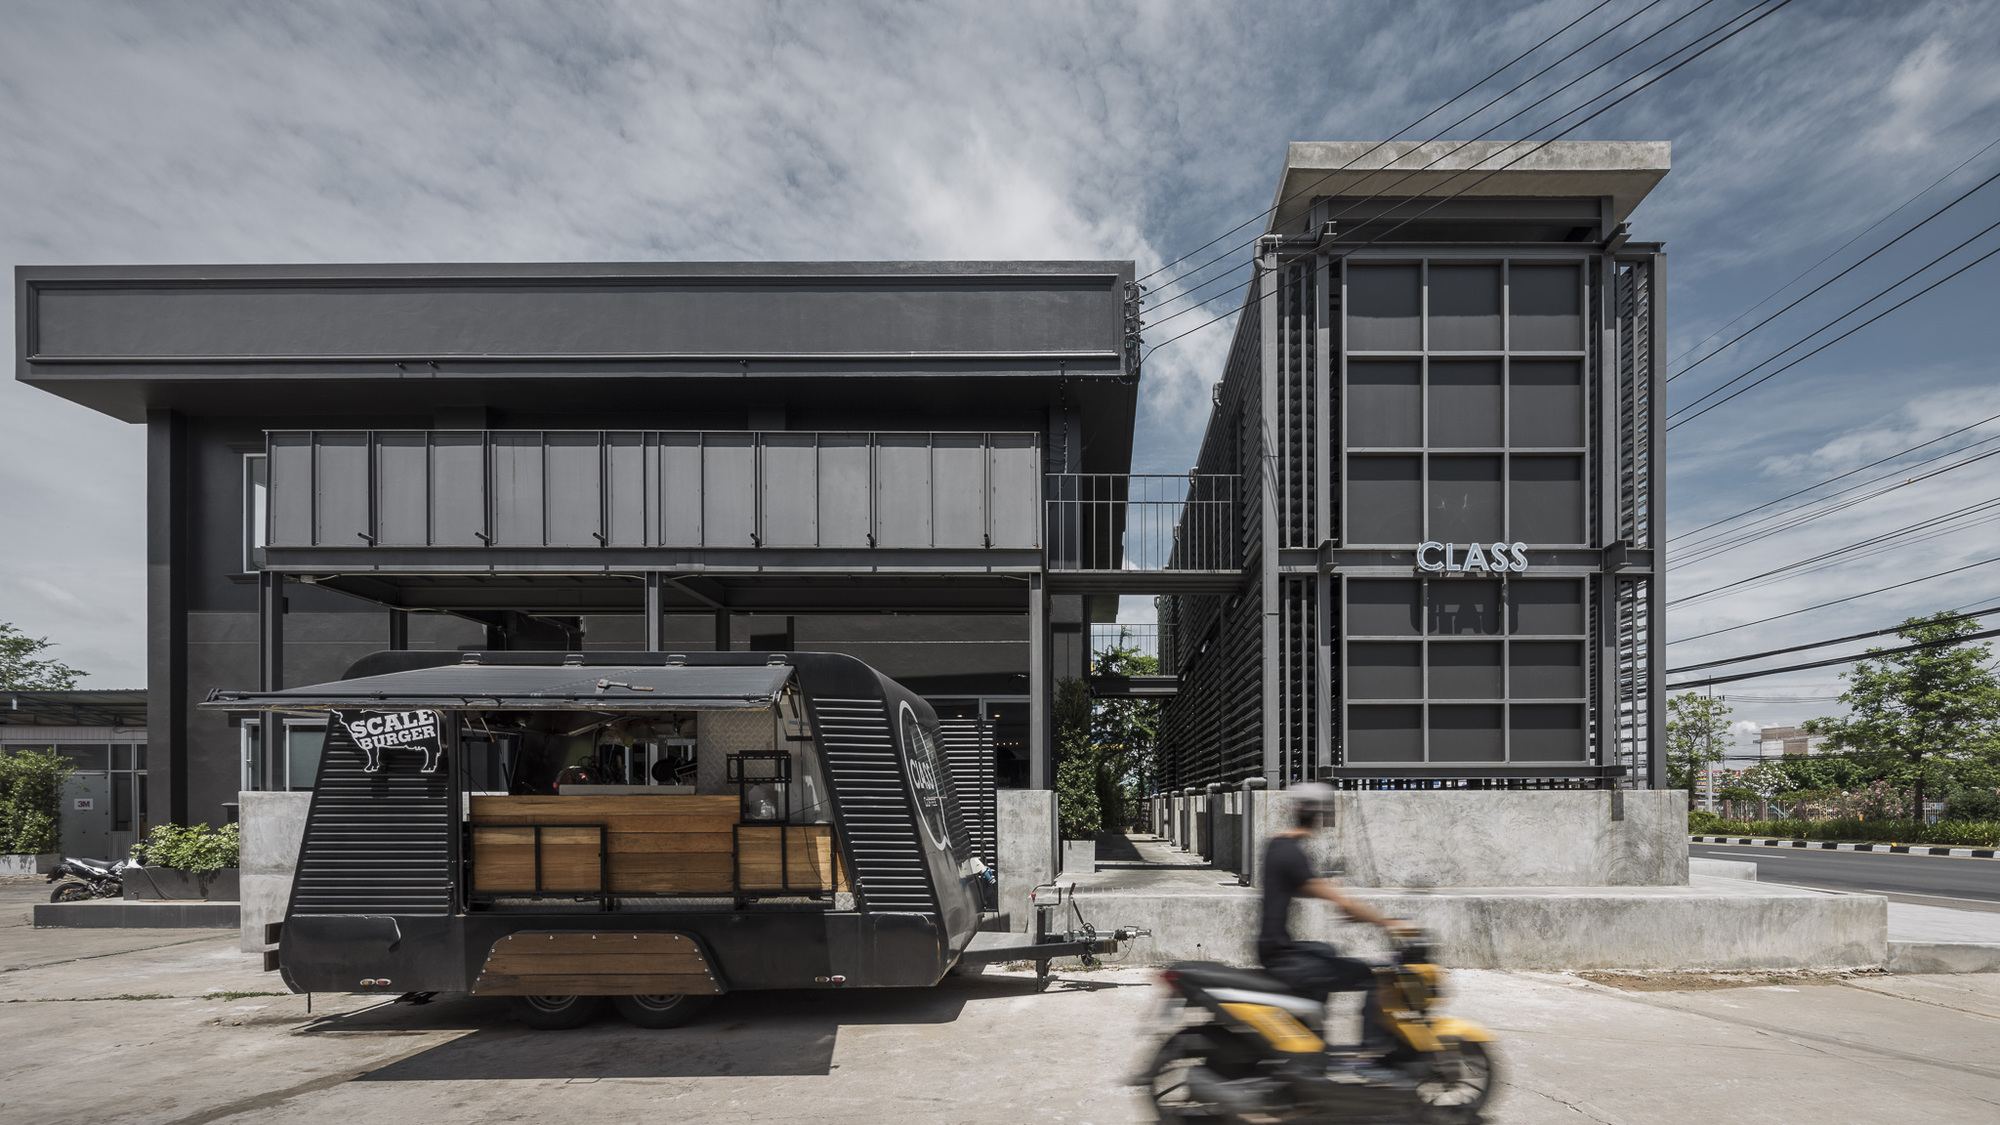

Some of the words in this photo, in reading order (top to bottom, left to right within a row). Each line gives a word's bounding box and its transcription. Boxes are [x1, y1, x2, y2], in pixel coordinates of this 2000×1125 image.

[1416, 541, 1528, 572] CLASS
[350, 709, 434, 738] SCALE
[359, 725, 436, 750] BURGER
[77, 800, 90, 808] 3M
